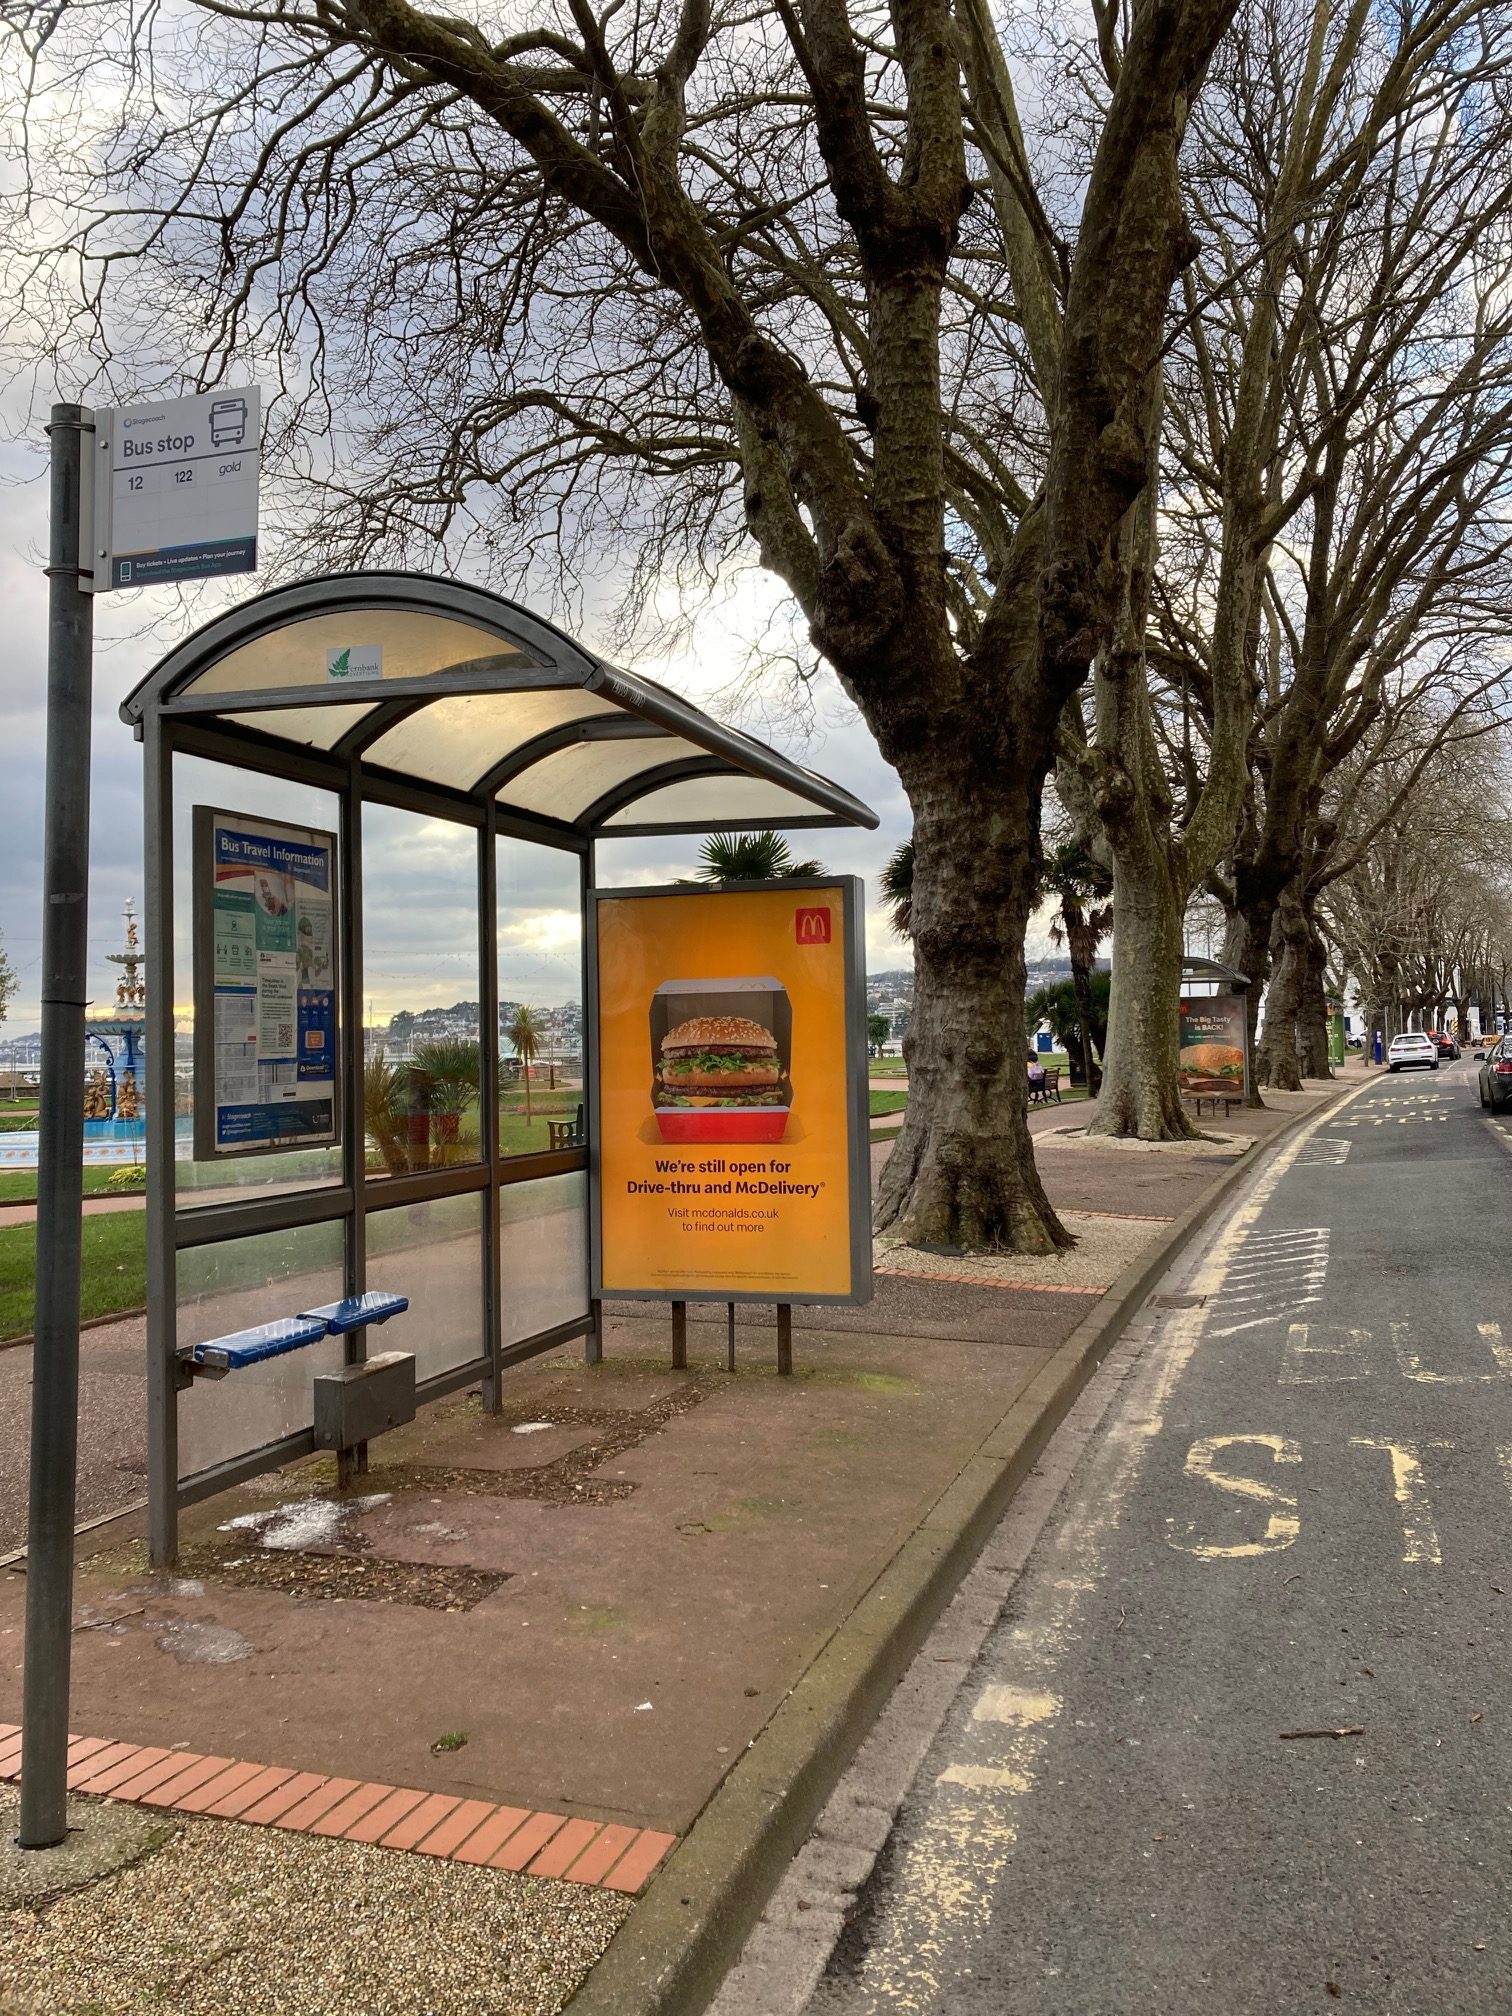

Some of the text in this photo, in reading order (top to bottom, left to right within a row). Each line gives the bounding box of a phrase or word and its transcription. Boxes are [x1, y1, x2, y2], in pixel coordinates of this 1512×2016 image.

[131, 414, 166, 425] Stagecoach
[123, 434, 195, 457] Bus stop
[128, 461, 242, 490] 12 122 gold
[178, 555, 199, 564] updates
[226, 549, 246, 557] journey
[221, 837, 240, 853] Bus
[242, 841, 271, 858] Travel
[273, 846, 324, 867] Information
[1199, 1016, 1212, 1024] Big
[1212, 1016, 1232, 1024] Tasty
[698, 1159, 726, 1173] still
[729, 1162, 766, 1176] open
[769, 1160, 791, 1173] for
[627, 1180, 701, 1194] Drive-thru
[704, 1180, 732, 1194] and
[667, 1208, 779, 1219] Visit mcdonalds.co.uk
[682, 1221, 765, 1233] to find out more
